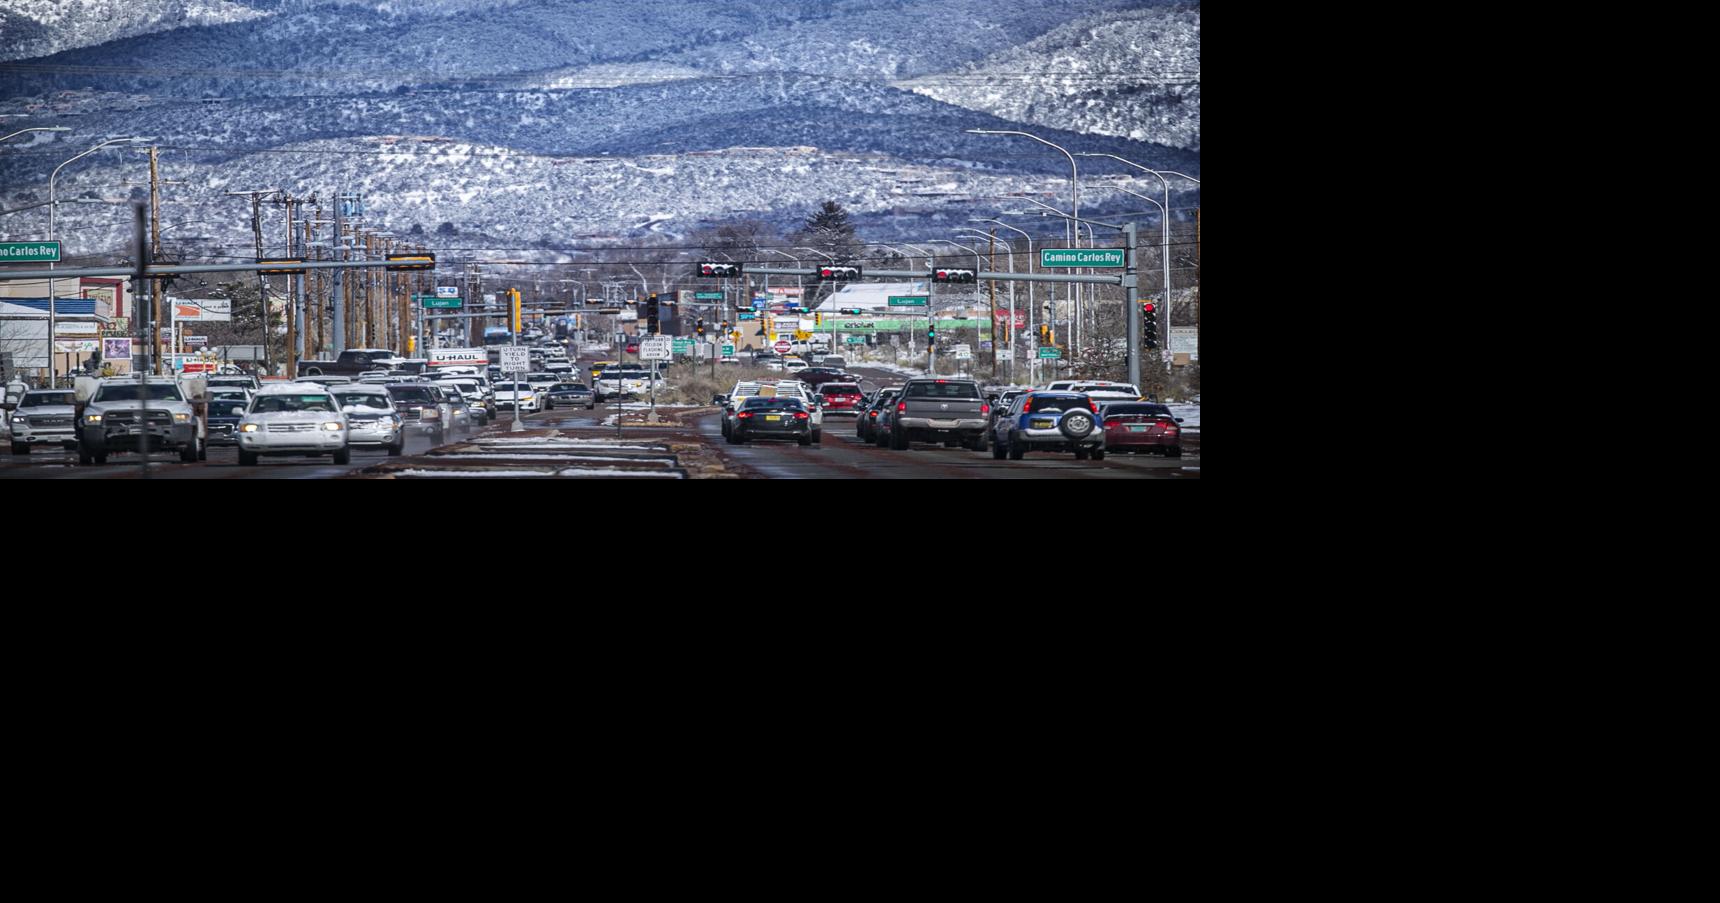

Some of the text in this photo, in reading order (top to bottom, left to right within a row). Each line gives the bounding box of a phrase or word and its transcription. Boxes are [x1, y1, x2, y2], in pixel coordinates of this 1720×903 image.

[10, 246, 38, 256] Carlos
[40, 245, 57, 258] Rey
[1044, 252, 1121, 264] Camino Carlos Rey
